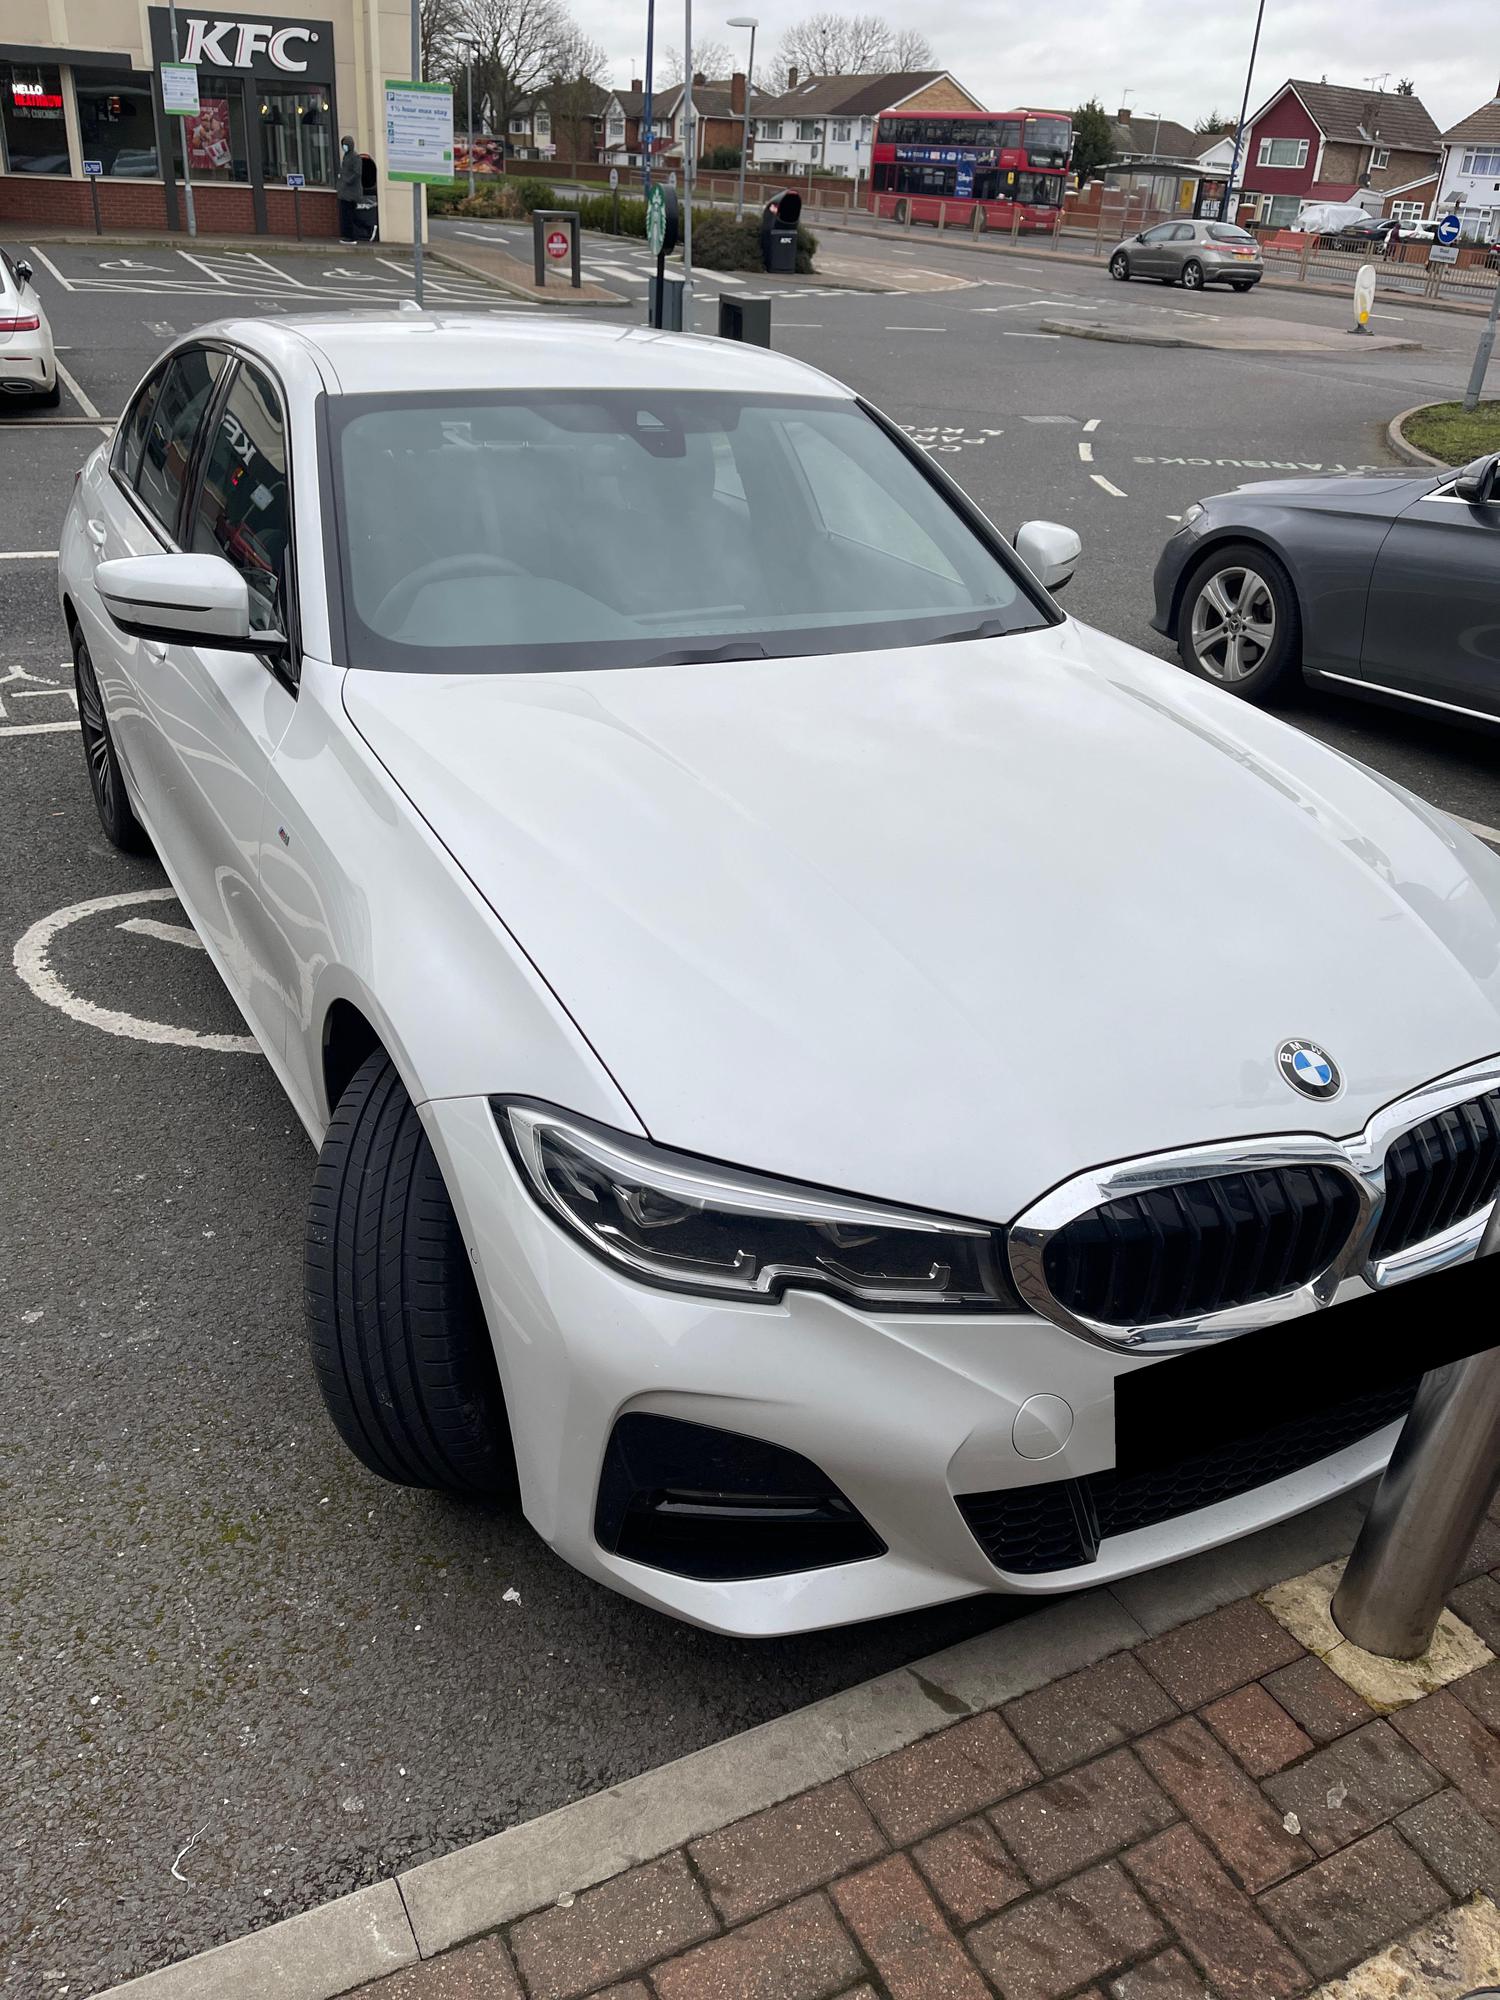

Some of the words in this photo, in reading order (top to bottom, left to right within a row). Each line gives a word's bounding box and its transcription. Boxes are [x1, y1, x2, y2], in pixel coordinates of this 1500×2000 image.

[180, 18, 310, 71] KFC
[12, 83, 43, 95] HELLO
[912, 434, 986, 445] PAR
[918, 443, 963, 452] CA
[1281, 1041, 1322, 1063] BMW
